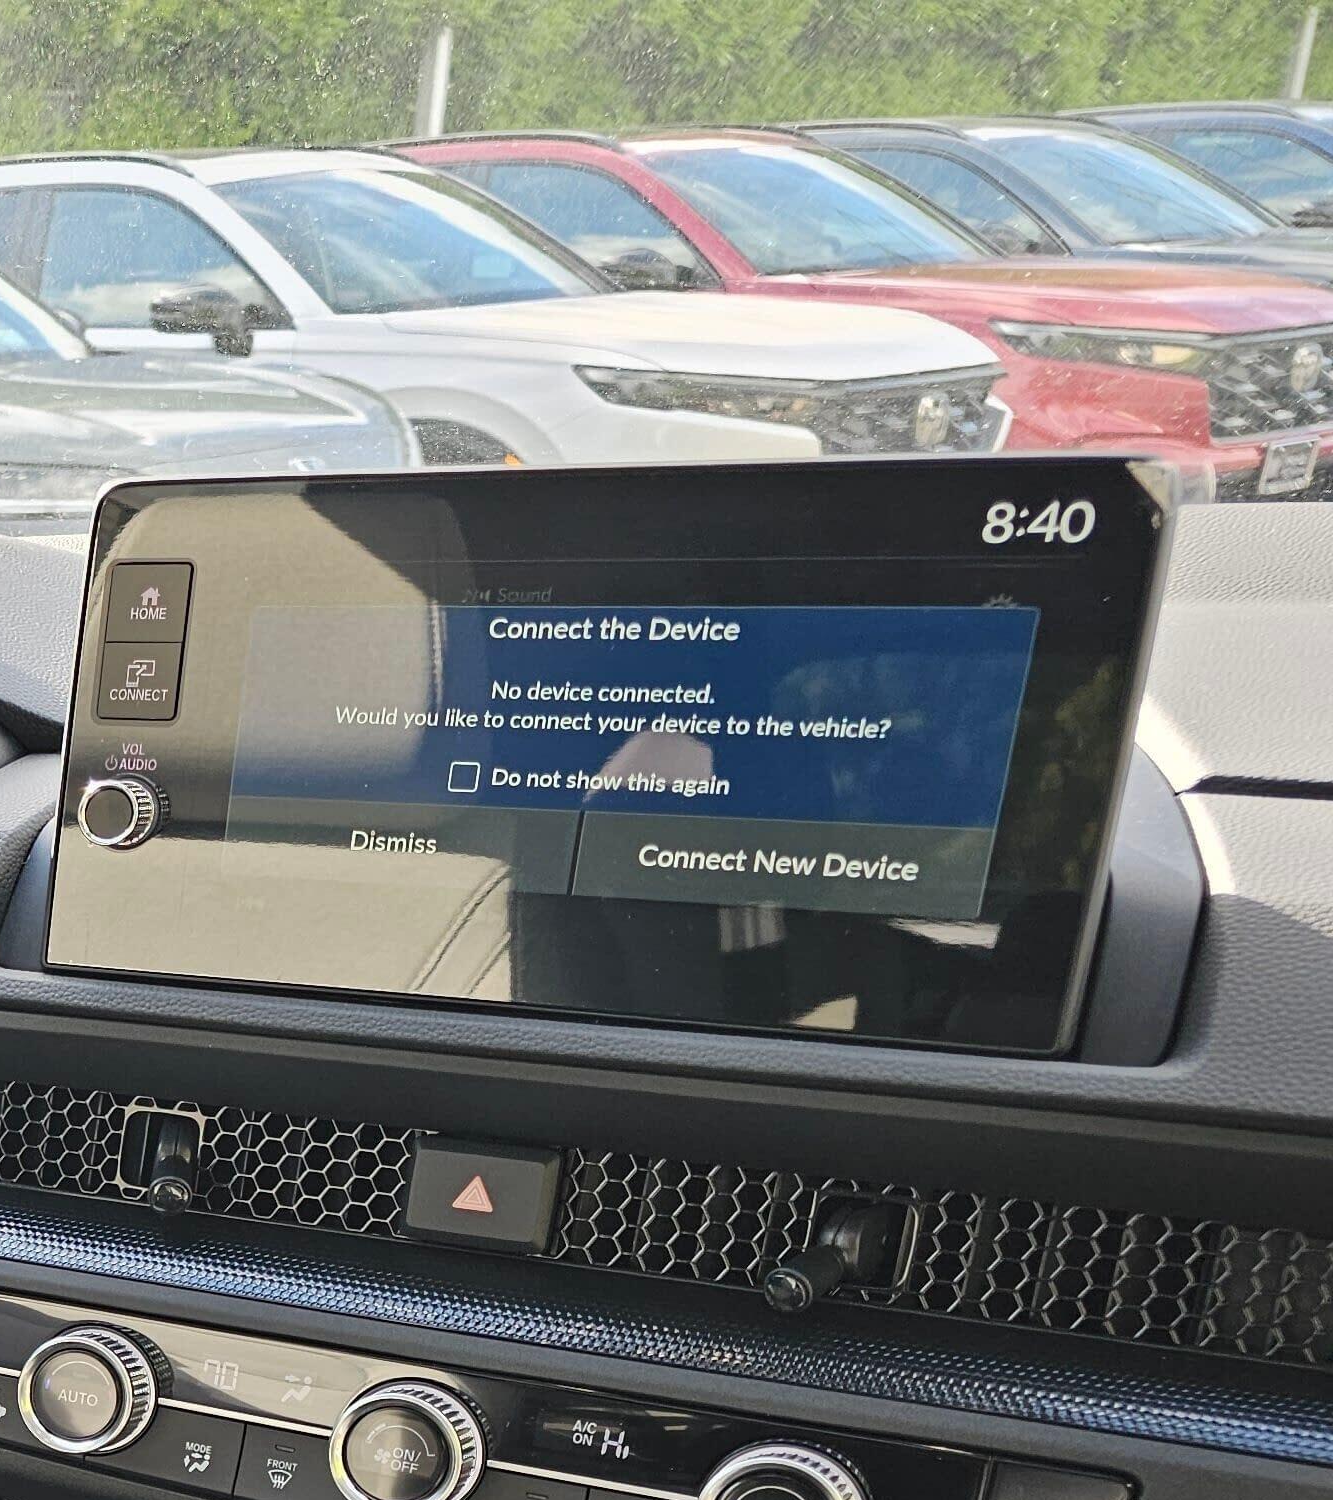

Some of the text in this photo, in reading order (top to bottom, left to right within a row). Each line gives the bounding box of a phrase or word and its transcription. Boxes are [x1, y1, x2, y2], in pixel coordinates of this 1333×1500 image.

[982, 500, 1096, 544] 8:40
[130, 607, 167, 620] HOME
[489, 615, 741, 641] Connect the Device
[109, 688, 168, 702] CONNECT
[491, 680, 715, 704] No device connected.
[336, 706, 892, 739] Would you like to connect your device to the vehicle?
[122, 743, 145, 755] VOL
[119, 758, 157, 771] AUDIO
[491, 768, 730, 797] Do not show this again
[350, 830, 437, 855] Dismiss
[638, 844, 919, 882] Connect New Device
[58, 1389, 98, 1407] AUTO
[572, 1419, 598, 1434] A/C
[572, 1433, 593, 1447] ON
[185, 1441, 212, 1455] MODE
[393, 1447, 422, 1462] ON/
[267, 1459, 298, 1471] FRONT
[390, 1459, 420, 1474] OFF
